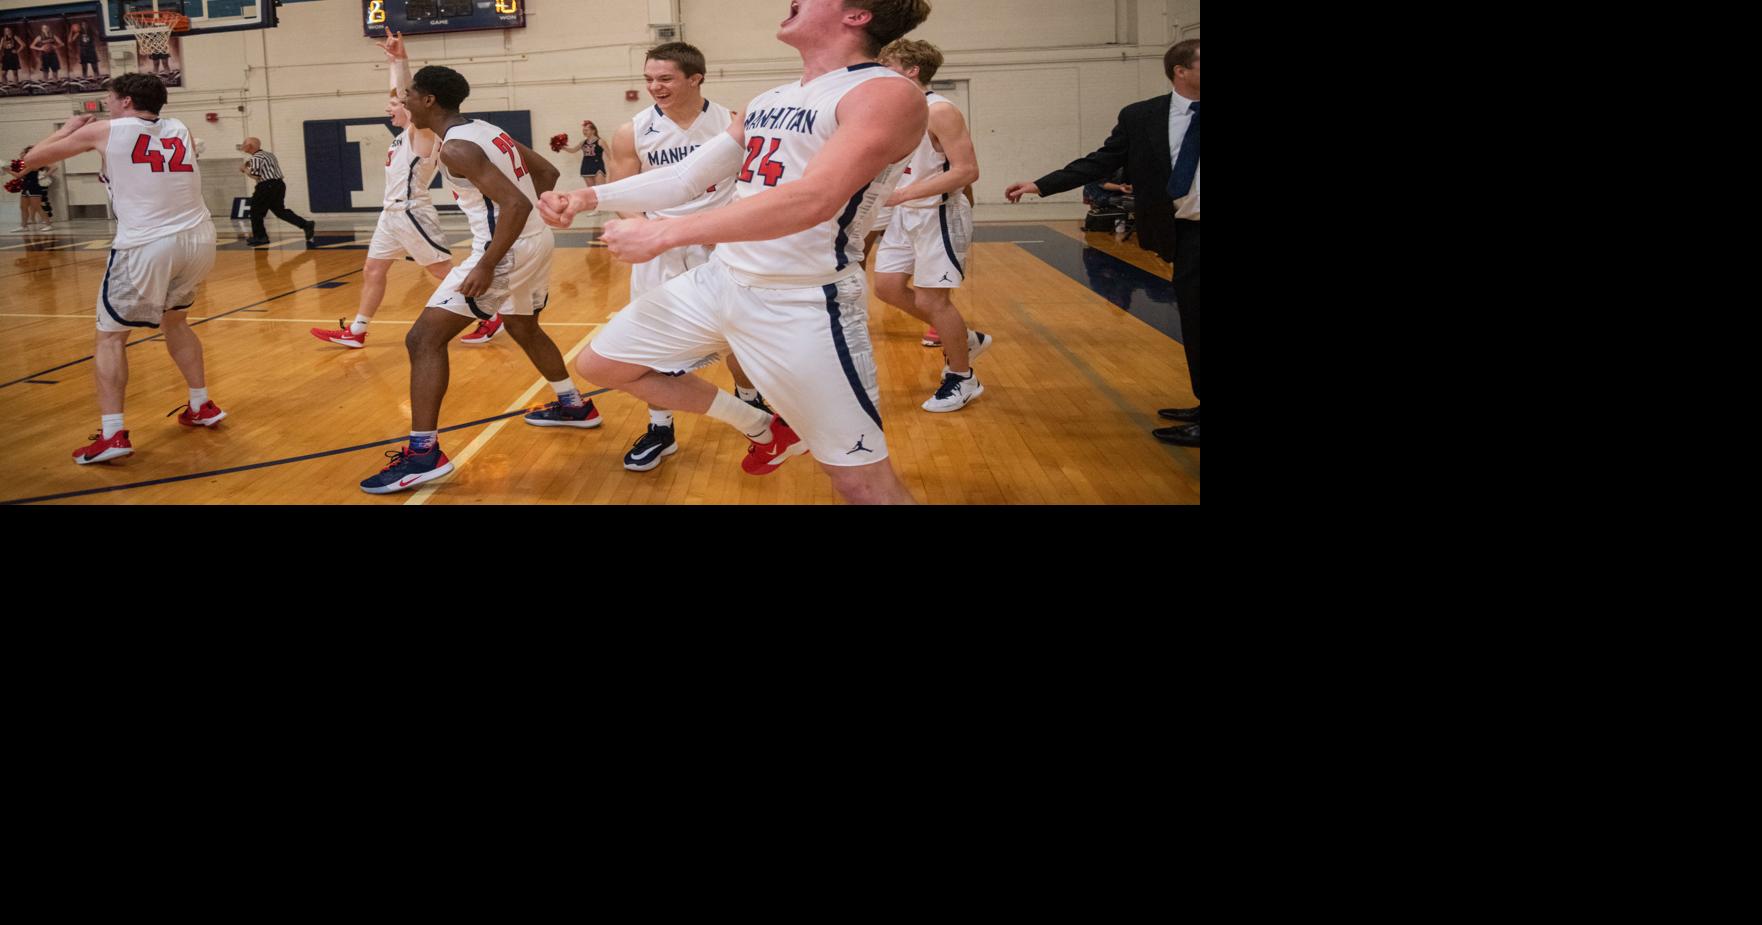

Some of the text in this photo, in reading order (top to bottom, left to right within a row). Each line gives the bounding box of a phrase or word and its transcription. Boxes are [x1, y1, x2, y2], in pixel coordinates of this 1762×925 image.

[744, 106, 818, 135] MANHTTAN
[131, 133, 194, 173] 42
[734, 135, 785, 187] 24
